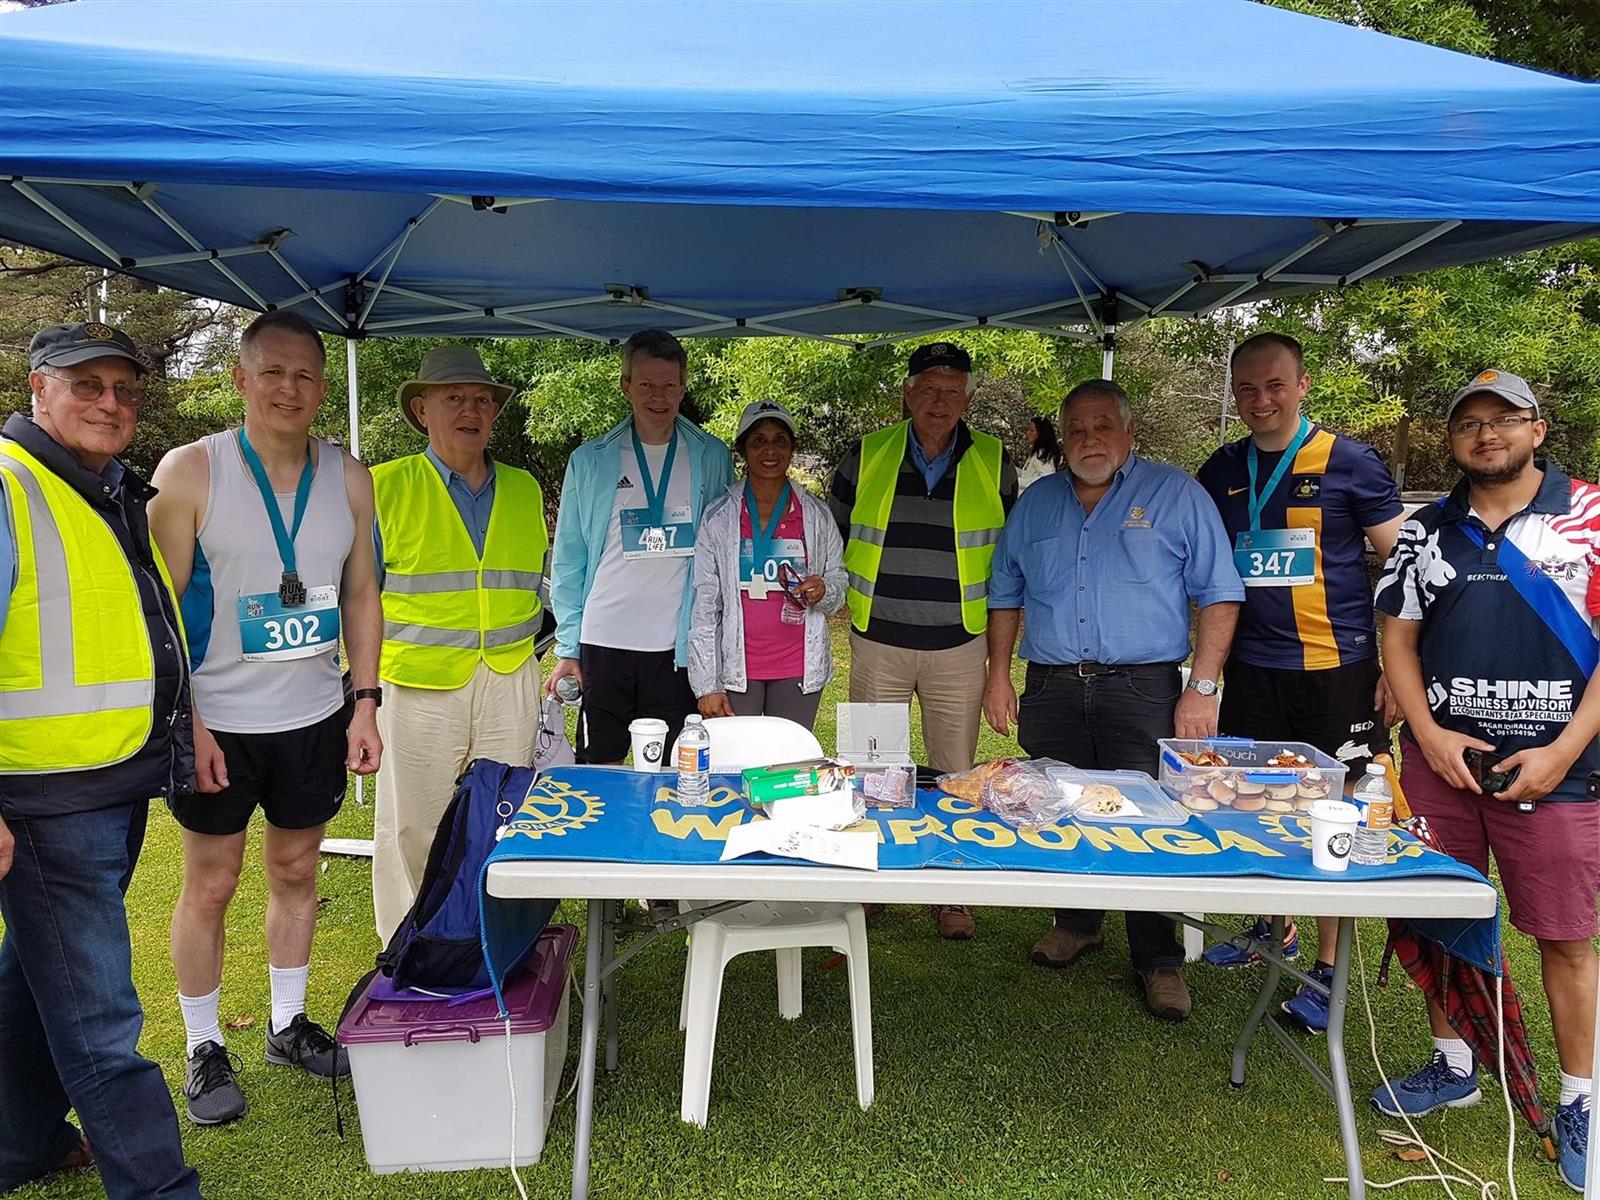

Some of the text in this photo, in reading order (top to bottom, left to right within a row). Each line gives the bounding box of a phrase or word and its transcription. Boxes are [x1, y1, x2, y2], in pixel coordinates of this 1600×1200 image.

[638, 526, 678, 547] 47
[648, 536, 663, 544] RUN
[1249, 551, 1295, 576] 347
[1467, 574, 1508, 582] BEASTWEAR
[280, 583, 303, 595] RUN
[263, 615, 321, 649] 302
[1450, 677, 1573, 700] SHINE
[1450, 696, 1573, 711] BUSINESS ADVISORY
[1451, 707, 1503, 719] ACCOUNTANTS
[1524, 711, 1572, 720] SPECIALISTS
[1478, 721, 1503, 729] SAGAR
[650, 807, 1287, 857] WROONGA
